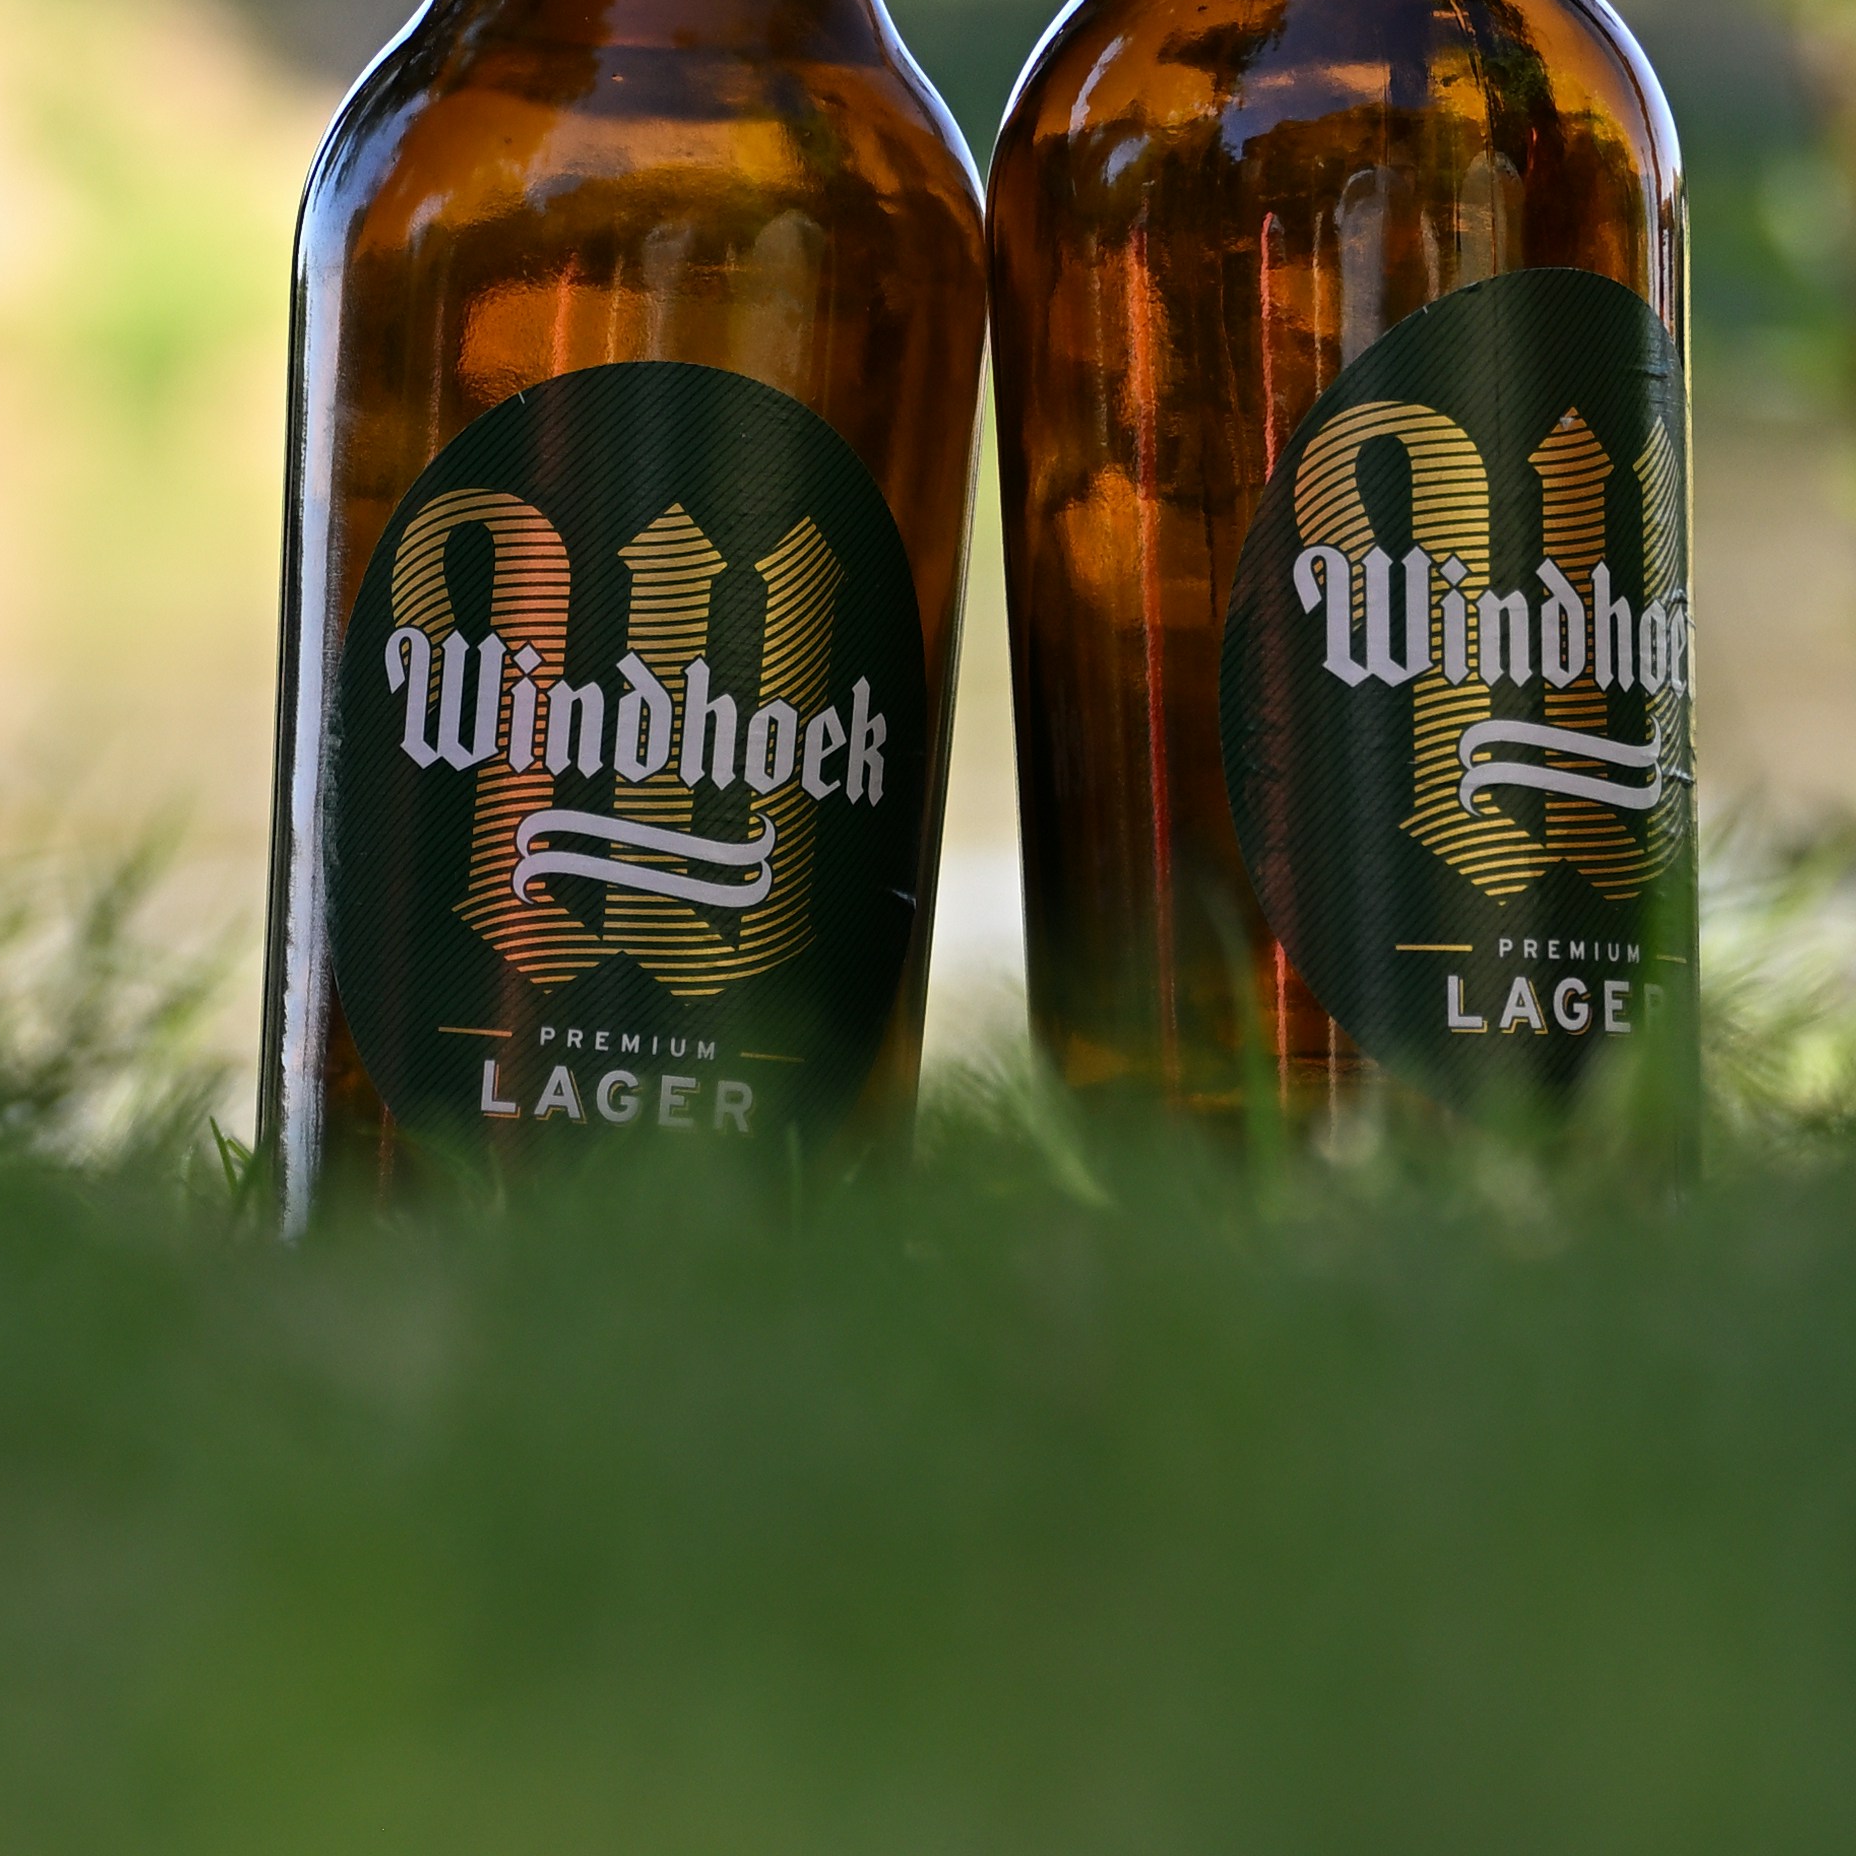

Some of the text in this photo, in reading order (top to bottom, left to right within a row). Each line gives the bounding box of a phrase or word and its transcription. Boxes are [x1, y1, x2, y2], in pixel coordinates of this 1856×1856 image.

[1292, 544, 1689, 701] Windhoe
[385, 625, 887, 807] Windhoek
[1498, 938, 1641, 964] PREMIUM
[539, 1026, 715, 1060] PREMIUM
[480, 1059, 754, 1135] LAGER
